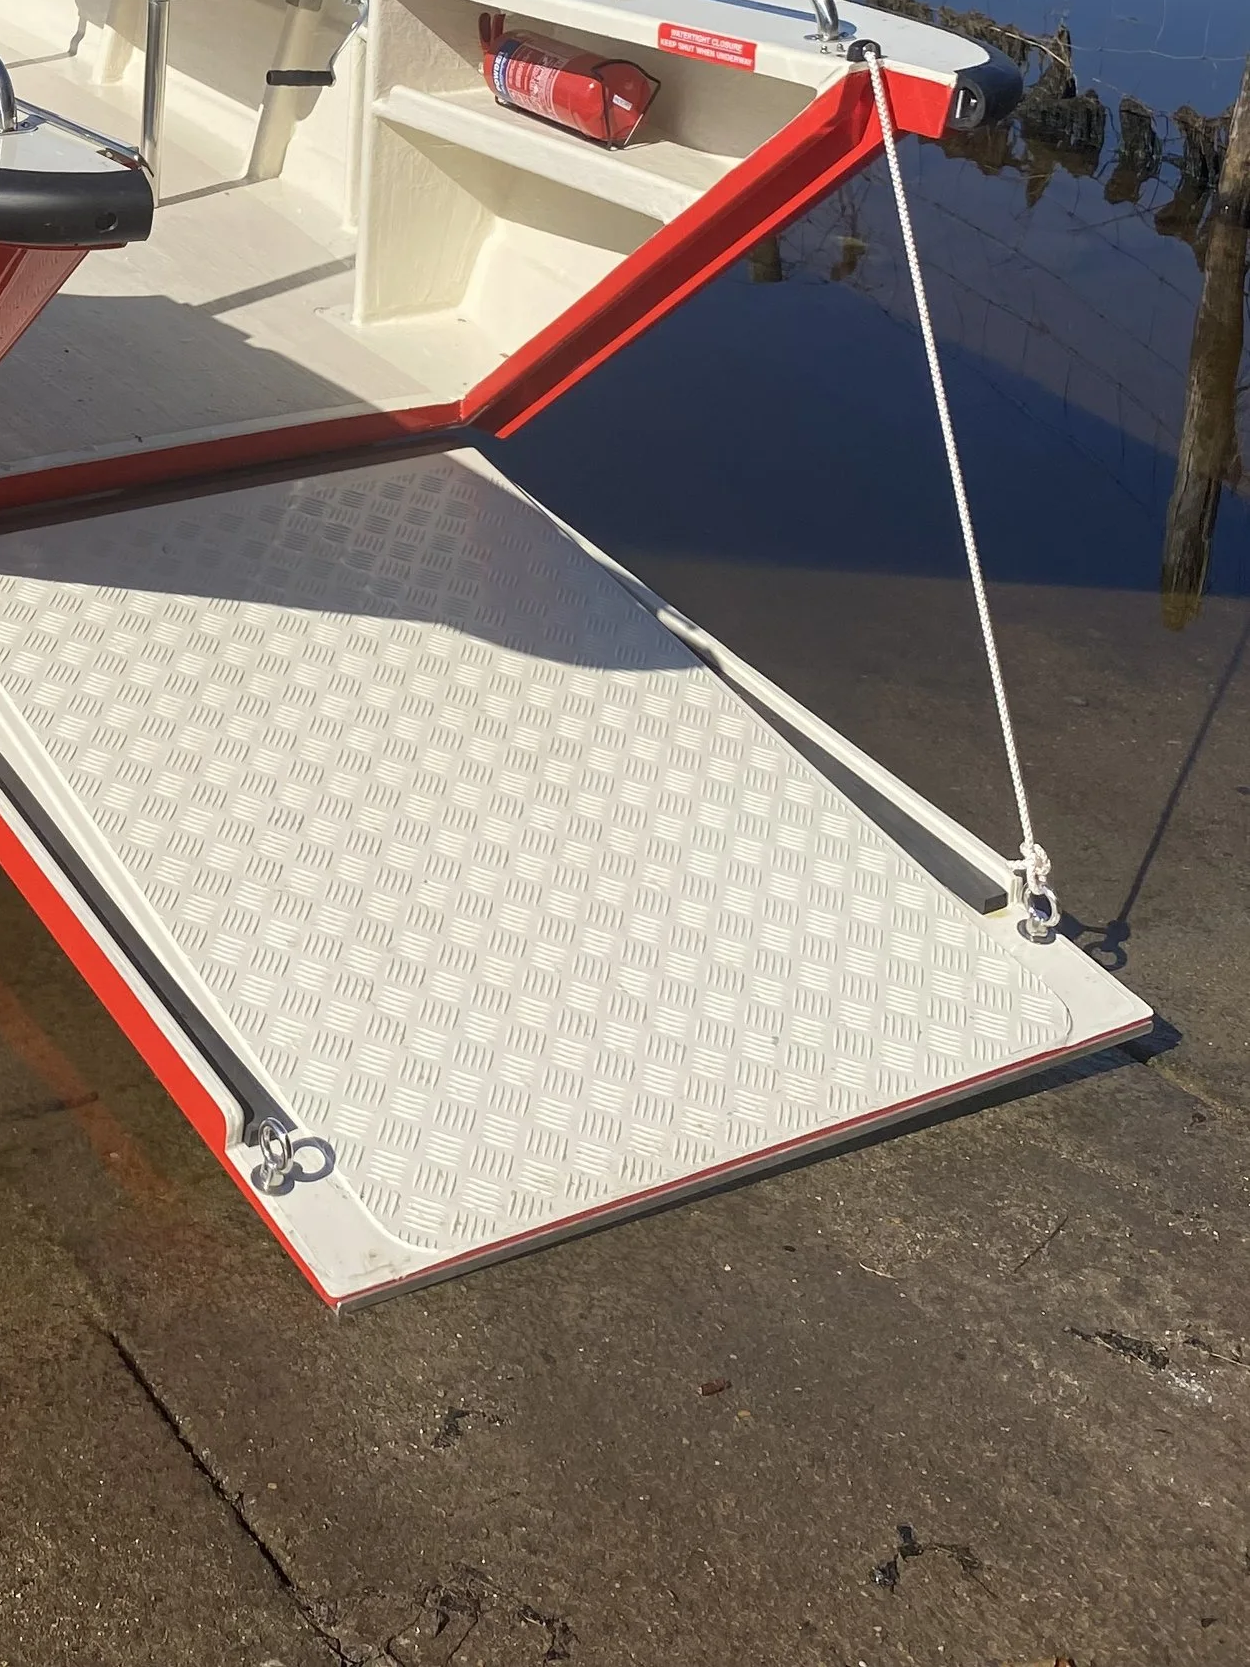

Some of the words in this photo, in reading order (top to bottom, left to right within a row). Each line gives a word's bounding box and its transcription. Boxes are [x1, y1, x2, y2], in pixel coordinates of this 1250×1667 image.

[661, 39, 677, 48] KEEP
[679, 43, 695, 53] SHUT
[711, 37, 743, 52] CLOSURE
